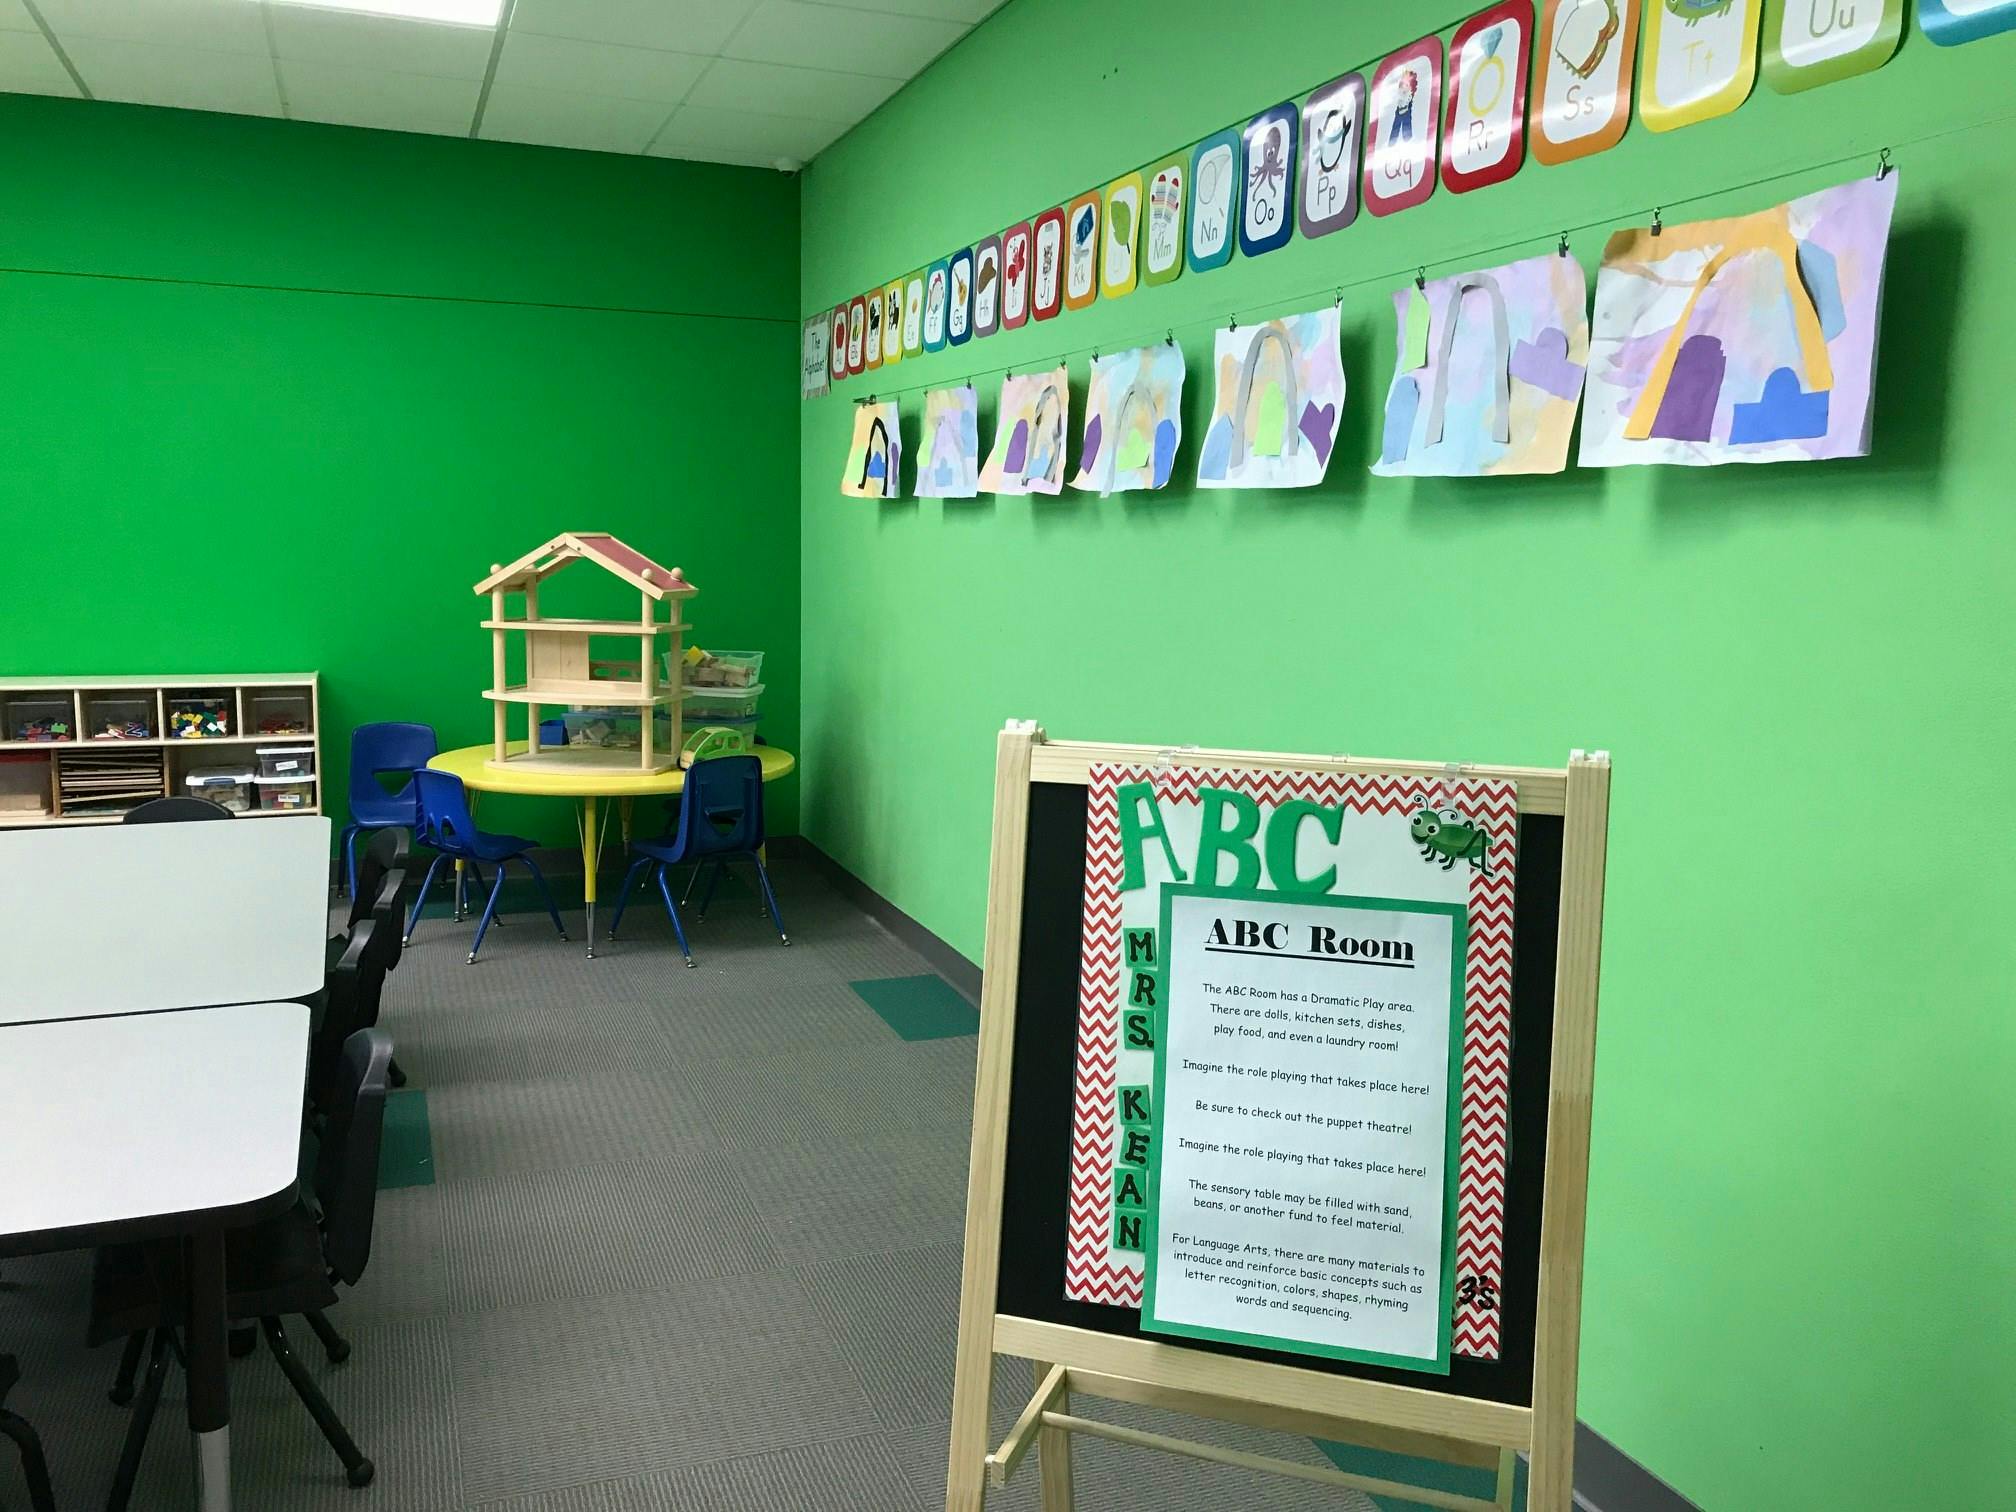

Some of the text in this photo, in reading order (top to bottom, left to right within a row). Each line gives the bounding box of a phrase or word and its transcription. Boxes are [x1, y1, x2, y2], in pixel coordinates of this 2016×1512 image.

[1808, 0, 1855, 38] Uu
[1682, 40, 1714, 74] Tt
[1562, 84, 1595, 121] Ss
[1466, 119, 1495, 155] Rr
[1254, 198, 1275, 226] Oo
[1316, 176, 1337, 214] Pp
[1199, 216, 1219, 245] Nn
[1117, 782, 1345, 893] ABC
[1203, 919, 1414, 961] ABC Room
[1202, 983, 1222, 994] The
[1225, 985, 1247, 996] ABC
[1249, 987, 1277, 999] Room
[1280, 989, 1298, 1001] has
[1311, 993, 1360, 1007] Dramatic
[1362, 997, 1384, 1012] Play
[1387, 1003, 1415, 1012] area.
[1209, 1003, 1405, 1033] There are dolls, kitchen sets, dishes,
[1214, 1024, 1398, 1051] play food, and even a laundry room!
[1182, 1059, 1429, 1095] Imagine the role playing that takes place here!
[1195, 1099, 1412, 1135] Be sure to check out the puppet theatre!
[1117, 1089, 1151, 1248] KEAN
[1178, 1137, 1426, 1177] Imagine the role playing that takes place here!
[1188, 1178, 1412, 1219] The sensory table may be filled with sand,
[1193, 1196, 1404, 1234] beans, or another fund to feel material.
[1172, 1232, 1425, 1277] For Language Arts, there are many materials to
[1173, 1250, 1422, 1294] introduce and reinforce basic concepts such as
[1185, 1267, 1409, 1312] letter recognition, colors, shapes, rhyming
[1236, 1295, 1352, 1321] words and sequencing.
